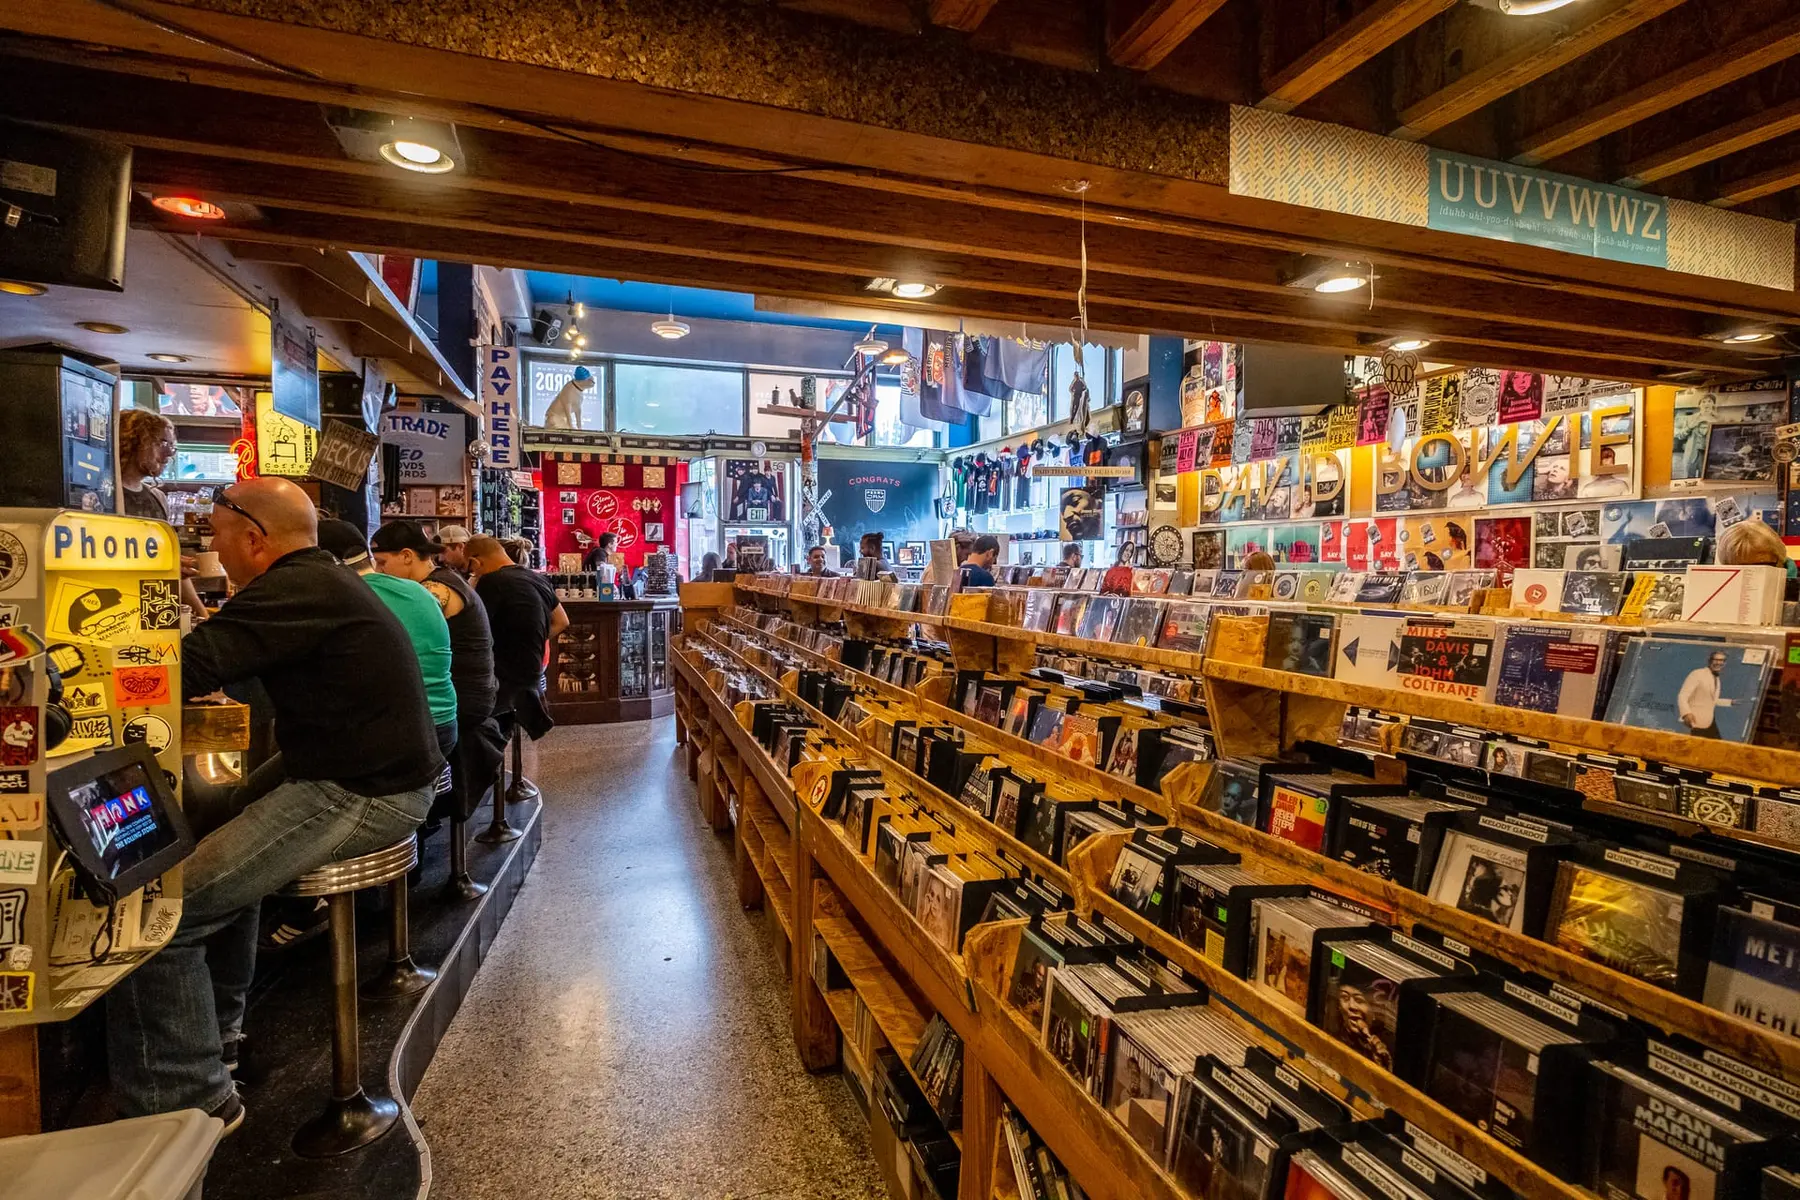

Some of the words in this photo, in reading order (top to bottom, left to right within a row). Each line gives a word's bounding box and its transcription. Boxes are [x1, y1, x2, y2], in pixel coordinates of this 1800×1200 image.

[491, 349, 511, 396] PAY
[388, 415, 450, 439] TRADE
[491, 401, 511, 464] HERE
[317, 435, 359, 470] HECK
[354, 449, 371, 473] IS
[400, 449, 424, 461] ED
[1376, 404, 1633, 495] BOWIE
[848, 475, 901, 487] CONGRATS
[751, 509, 764, 520] EXIT
[54, 525, 158, 559] Phone
[1407, 626, 1448, 639] MILES
[1425, 640, 1470, 656] DAVIS
[1413, 664, 1455, 681] JOHN
[1438, 655, 1448, 667] &
[1402, 677, 1478, 697] COLTRANE
[1276, 791, 1298, 805] MILES
[1272, 818, 1295, 831] STEPS
[1274, 808, 1296, 822] SEVEN
[1271, 825, 1280, 835] TO
[1480, 816, 1511, 831] MELODY
[1512, 825, 1546, 841] GARDOT
[1606, 851, 1641, 868] QUINCY
[1642, 861, 1675, 877] JONES
[1310, 890, 1339, 905] MILES
[1341, 902, 1371, 917] DAVIS
[1393, 933, 1409, 946] ELLA
[1410, 941, 1454, 967] FITZGERALD
[1445, 938, 1463, 950] JAZZ
[1506, 982, 1532, 1001] BILLIE
[1534, 996, 1575, 1021] HOLIDAY
[1275, 1068, 1292, 1083] JAZZ
[1708, 1053, 1754, 1078] SERGIO
[1214, 1068, 1236, 1092] SAMMY
[1236, 1087, 1255, 1107] DAVIS
[1654, 1060, 1685, 1080] DEAN
[1690, 1079, 1735, 1105] MARTIN
[1711, 1070, 1758, 1097] MARTIN
[1760, 1092, 1771, 1103] &
[1649, 1096, 1712, 1140] DEAN
[1634, 1104, 1725, 1162] MARTIN
[1408, 1123, 1439, 1150] HERBIE
[1440, 1143, 1483, 1178] HANCOCK
[1345, 1151, 1367, 1175] JOSH
[1404, 1153, 1426, 1173] JAZZ
